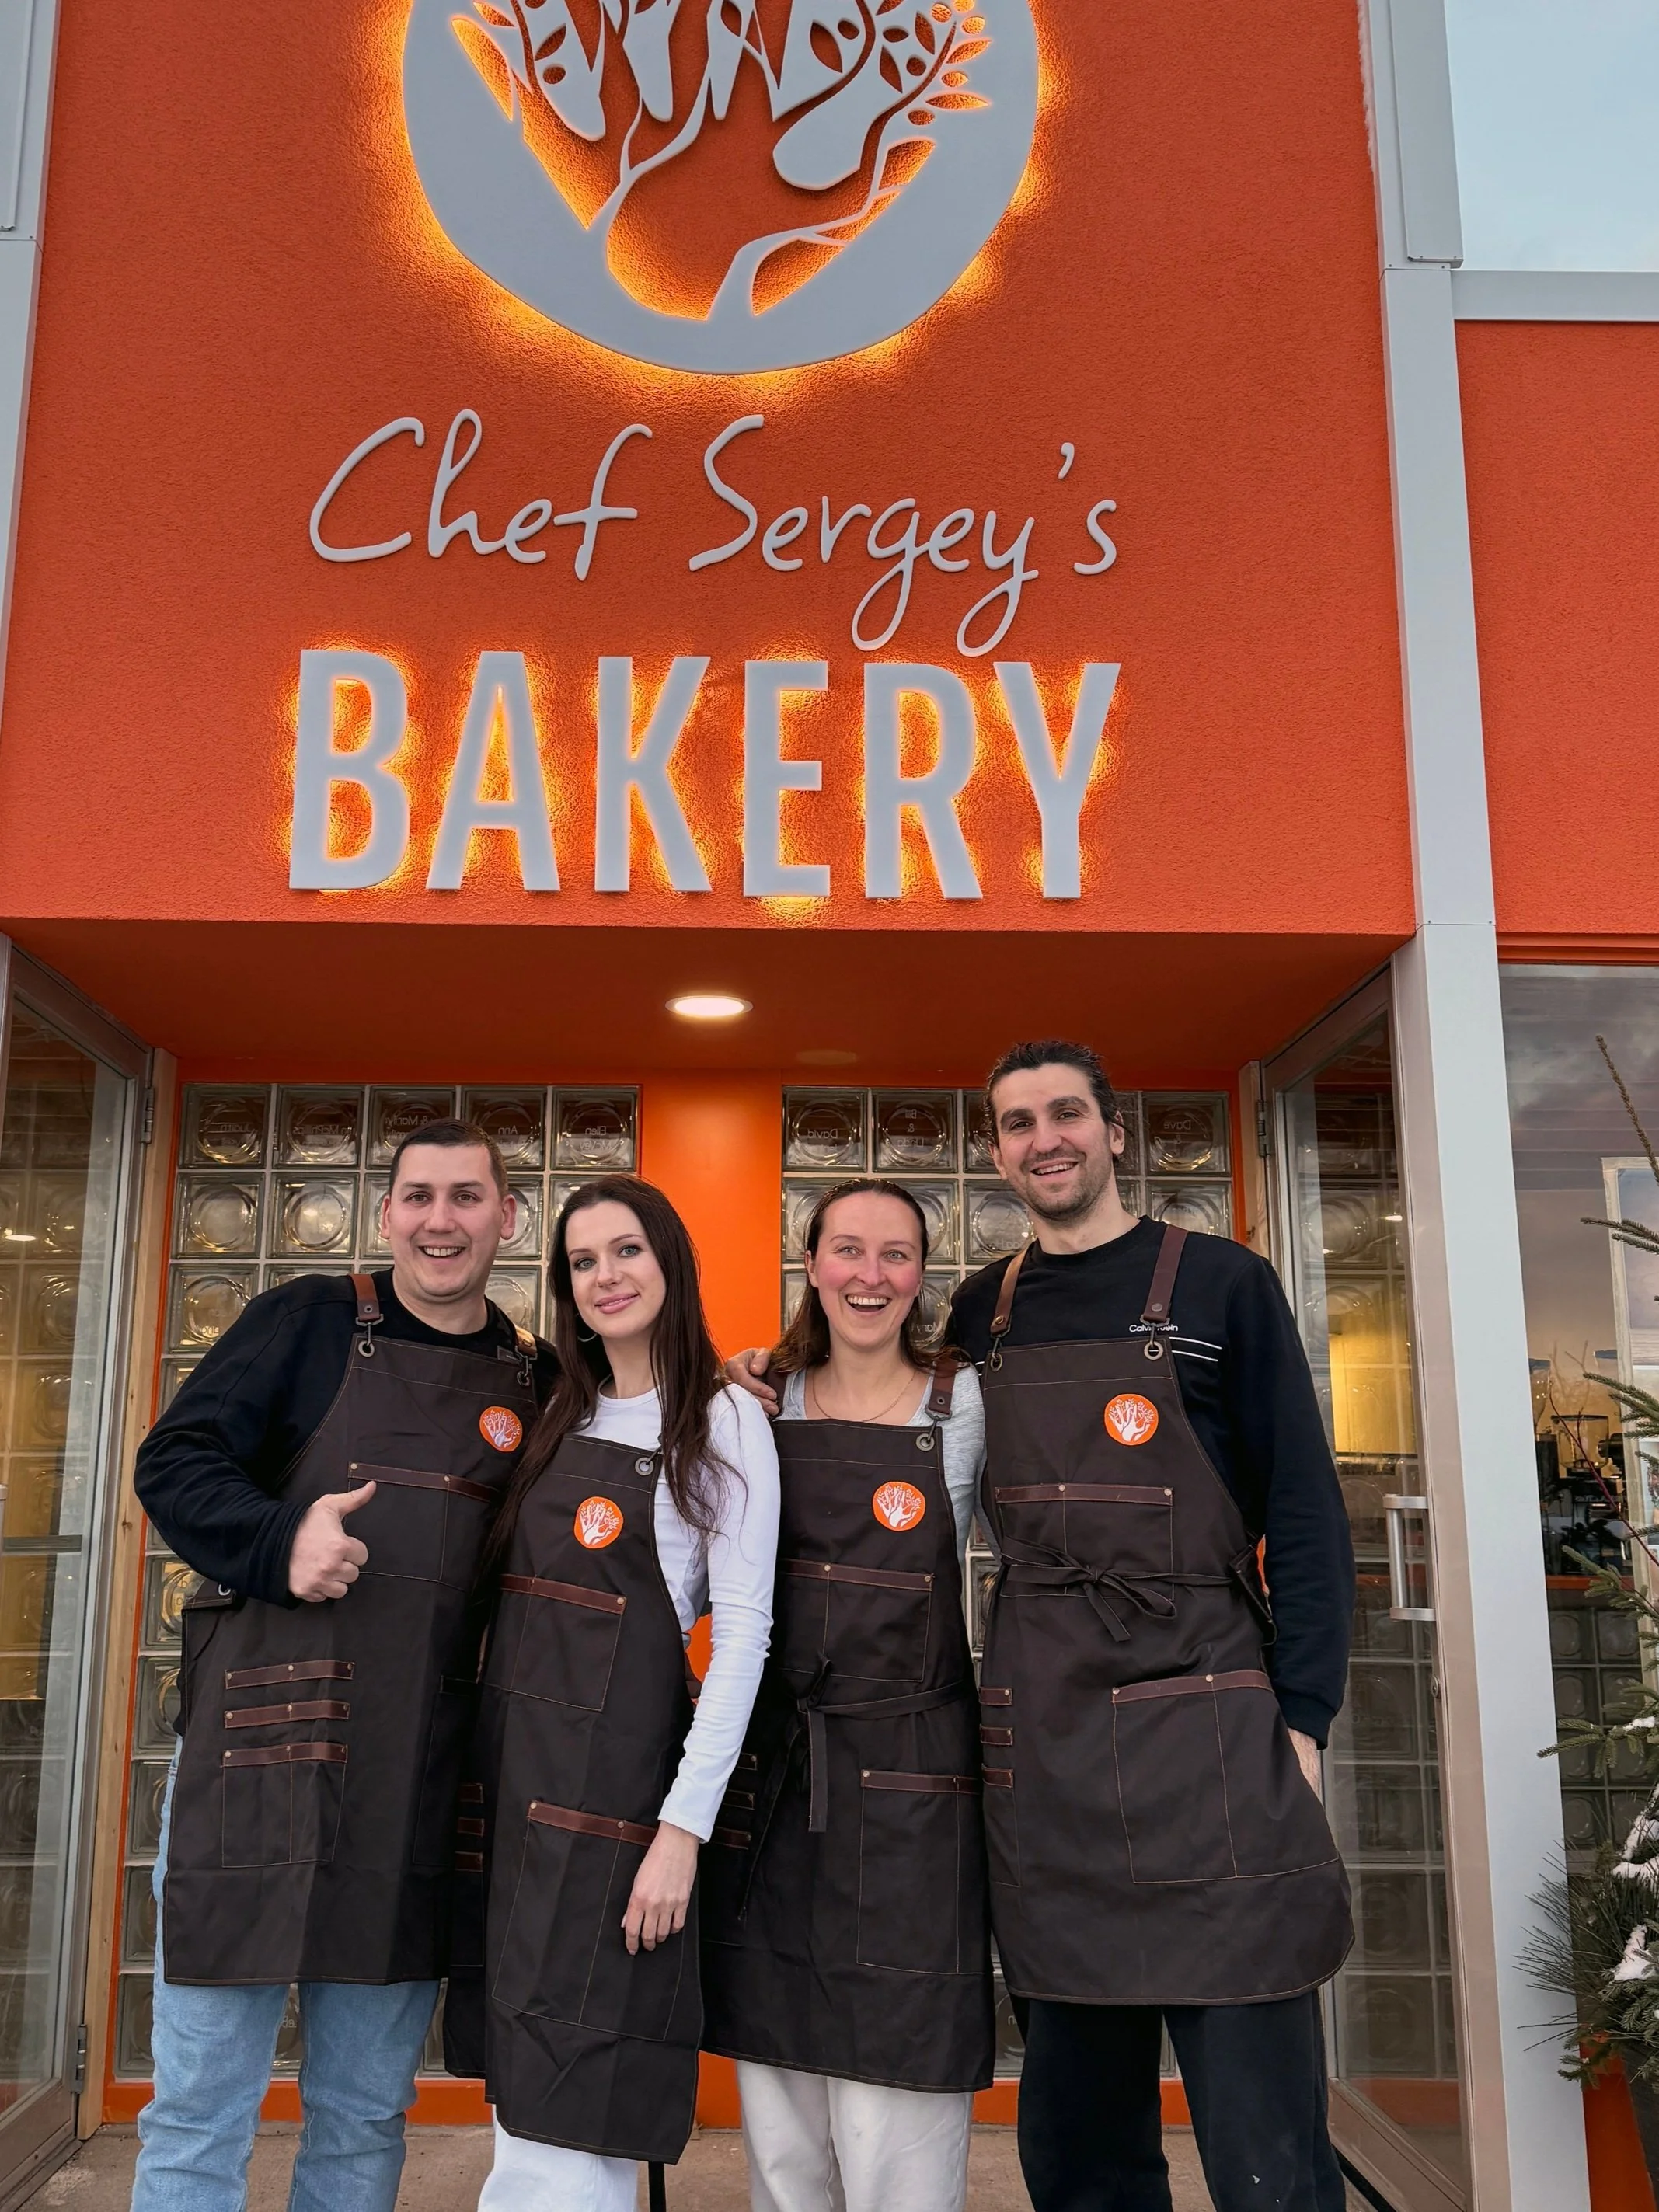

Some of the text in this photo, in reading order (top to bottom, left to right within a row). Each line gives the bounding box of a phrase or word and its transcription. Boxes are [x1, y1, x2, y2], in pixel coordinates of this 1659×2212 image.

[309, 409, 1118, 657] Chef Sergey's
[288, 648, 1122, 900] BAKERY
[1128, 1324, 1152, 1332] Calv
